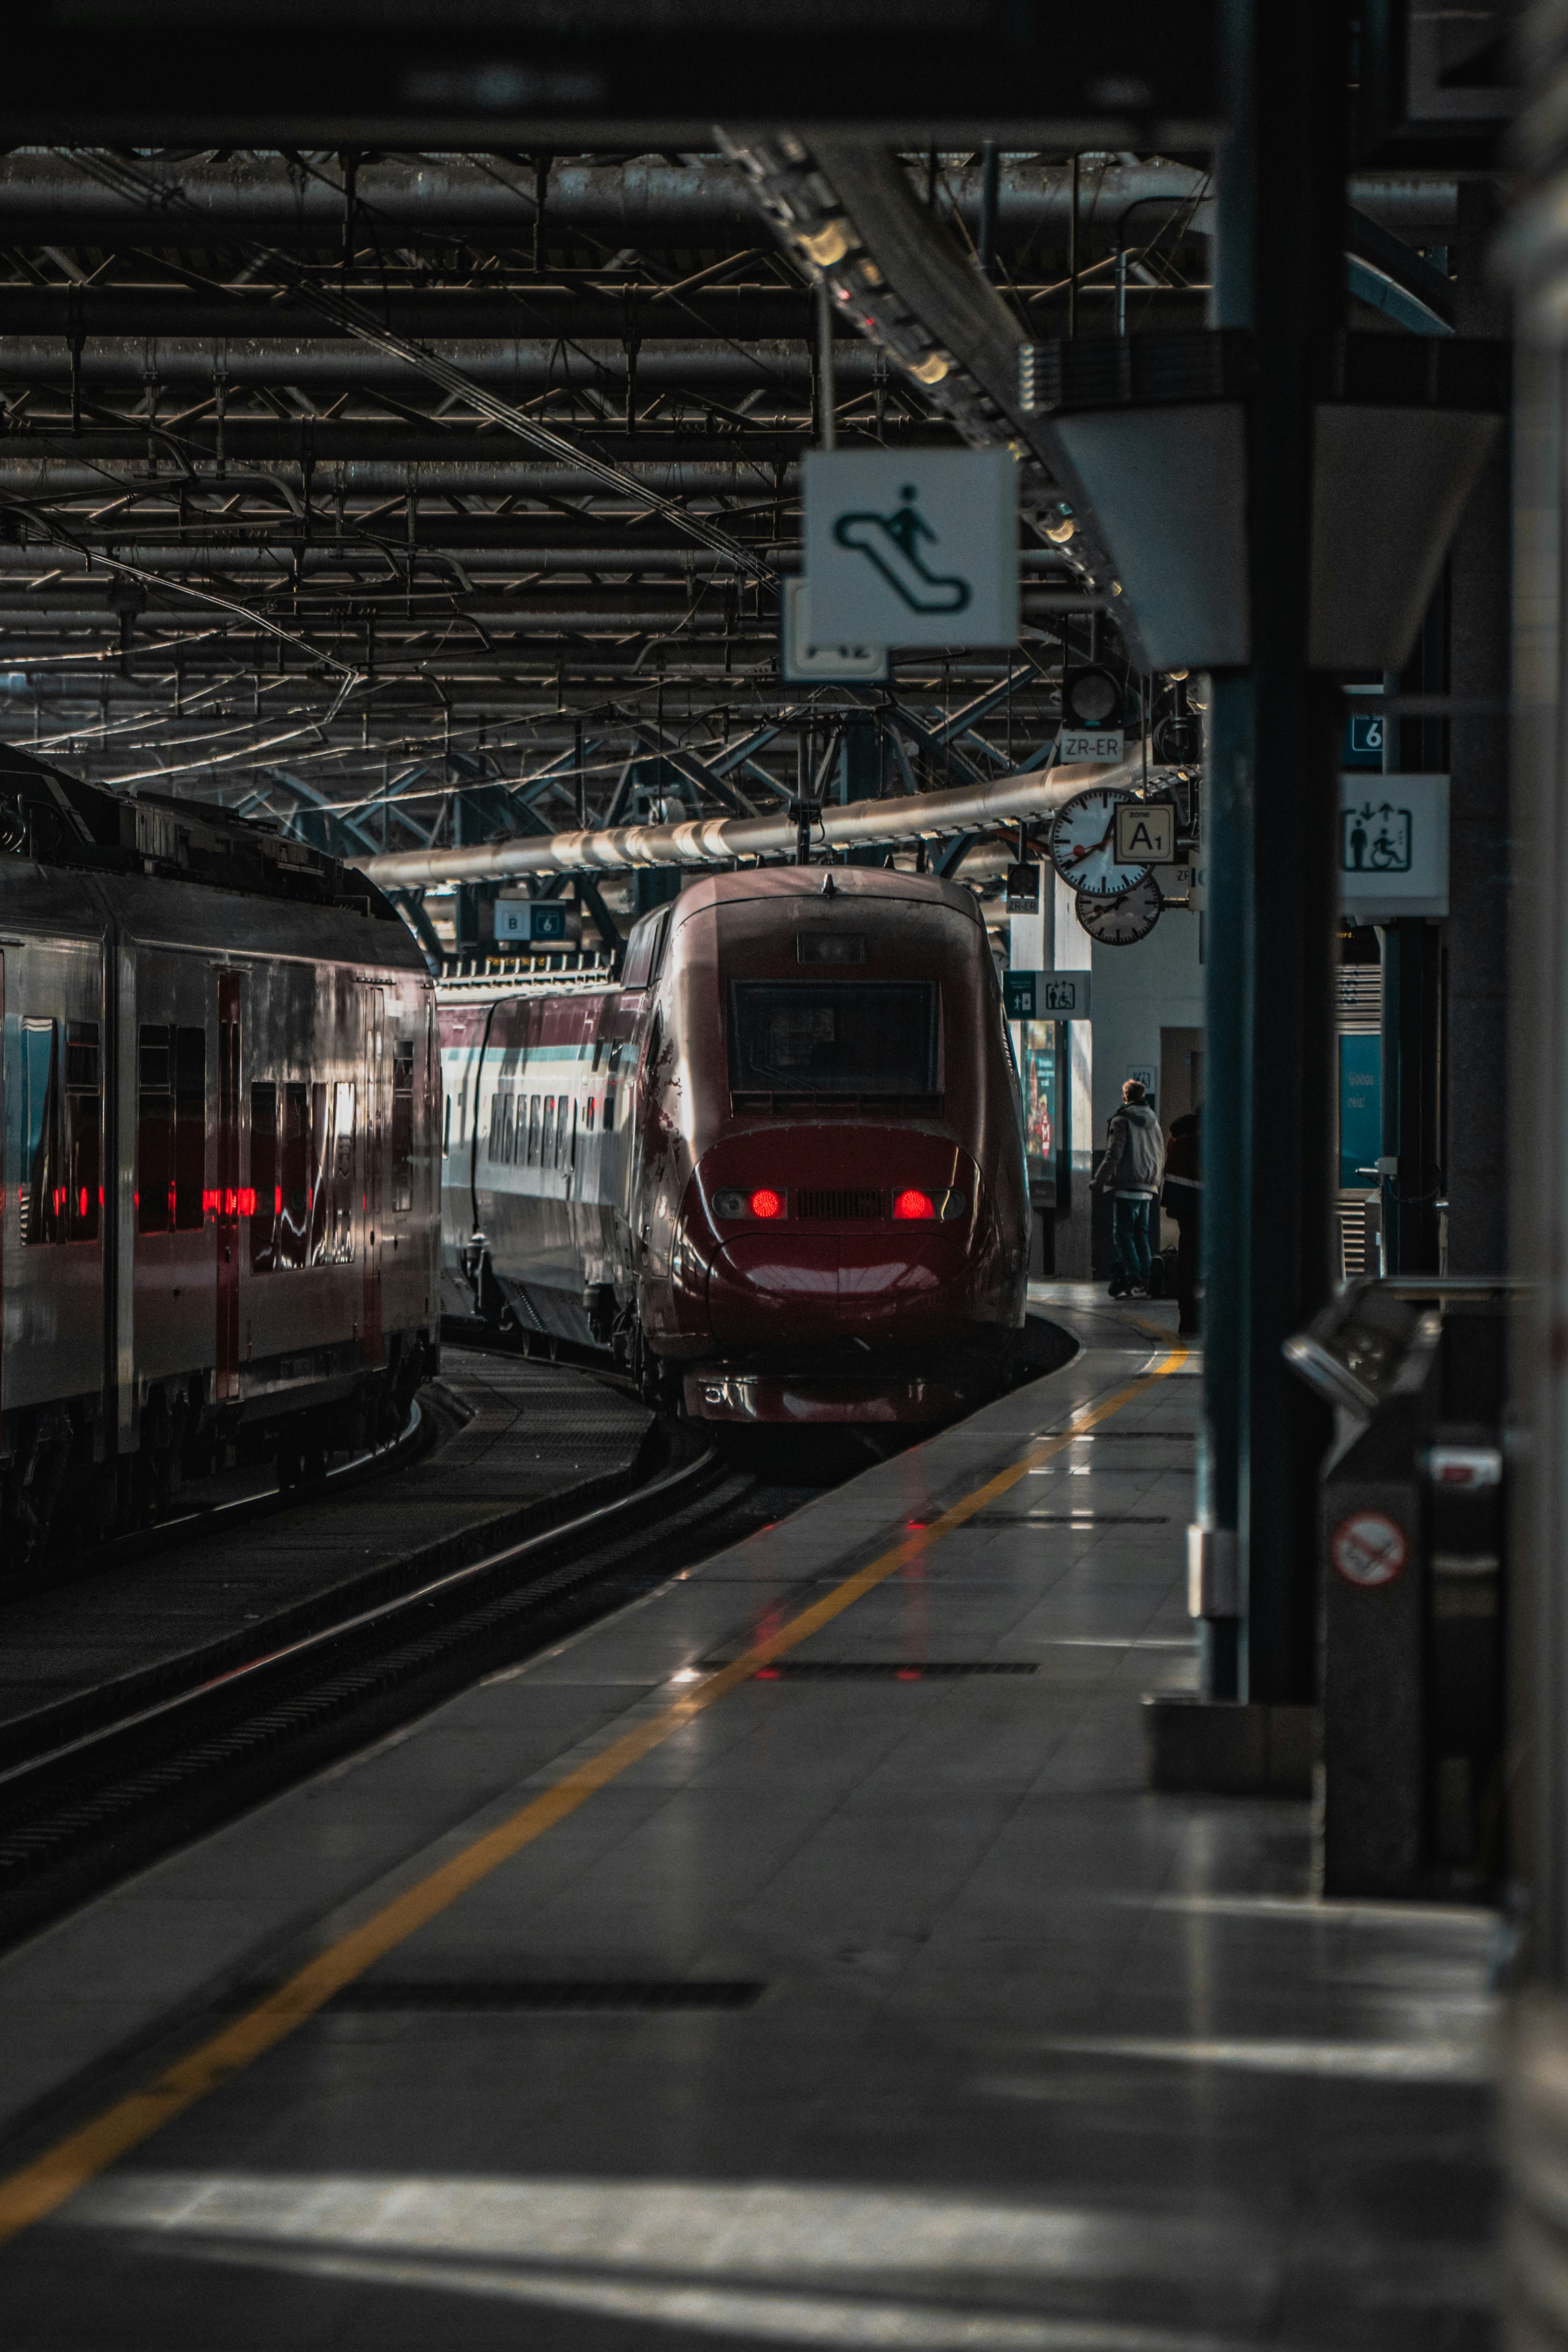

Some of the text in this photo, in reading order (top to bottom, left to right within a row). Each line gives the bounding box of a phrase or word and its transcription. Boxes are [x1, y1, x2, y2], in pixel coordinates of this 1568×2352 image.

[1366, 723, 1382, 747] 6
[1067, 739, 1118, 755] ZR-ER
[1009, 902, 1036, 910] ZR-ER
[508, 918, 517, 929] B
[543, 918, 552, 932] 6
